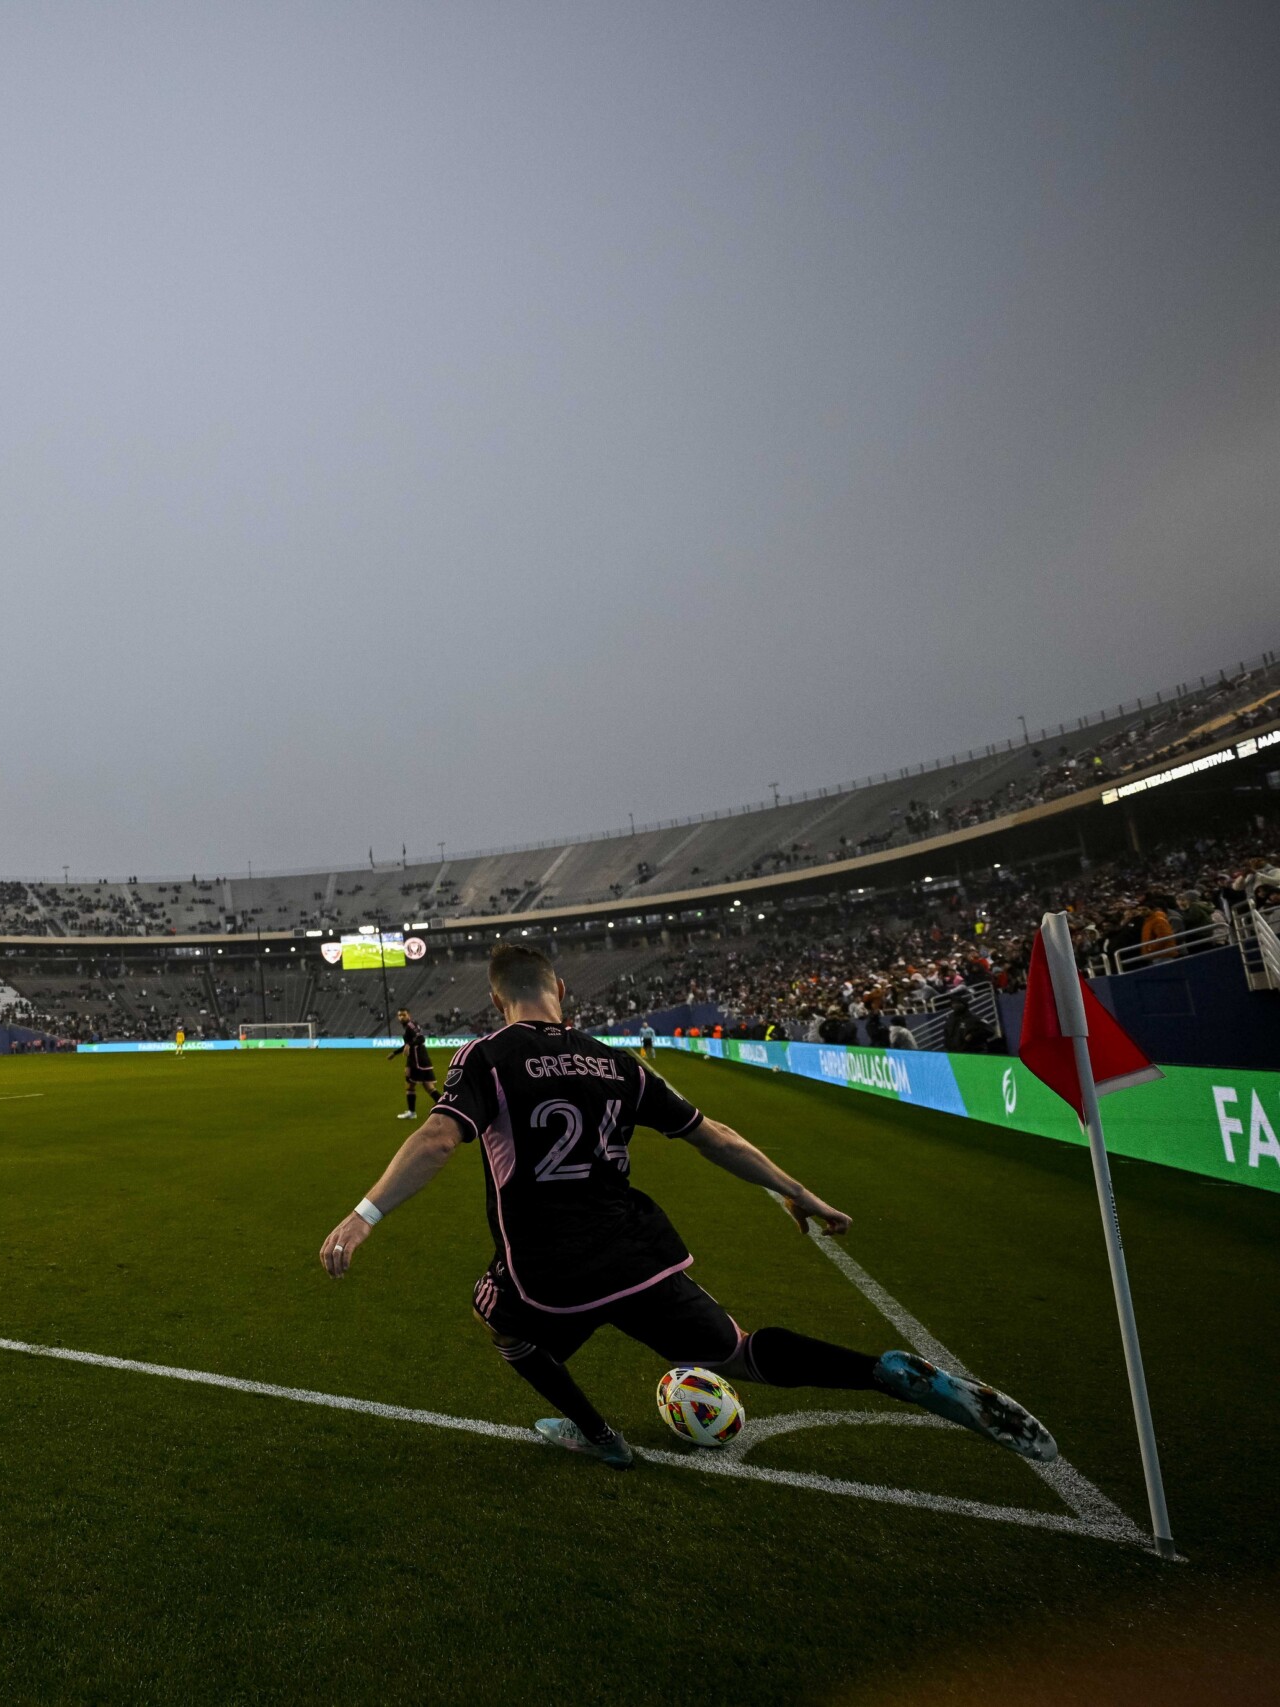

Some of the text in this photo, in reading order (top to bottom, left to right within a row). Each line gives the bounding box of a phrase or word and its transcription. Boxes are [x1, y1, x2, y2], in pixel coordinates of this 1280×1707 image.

[373, 1038, 468, 1047] FAIRPALLAS.COM
[525, 1054, 624, 1081] GRESSEL
[818, 1049, 912, 1094] FAIRPARKDALLAS.COM
